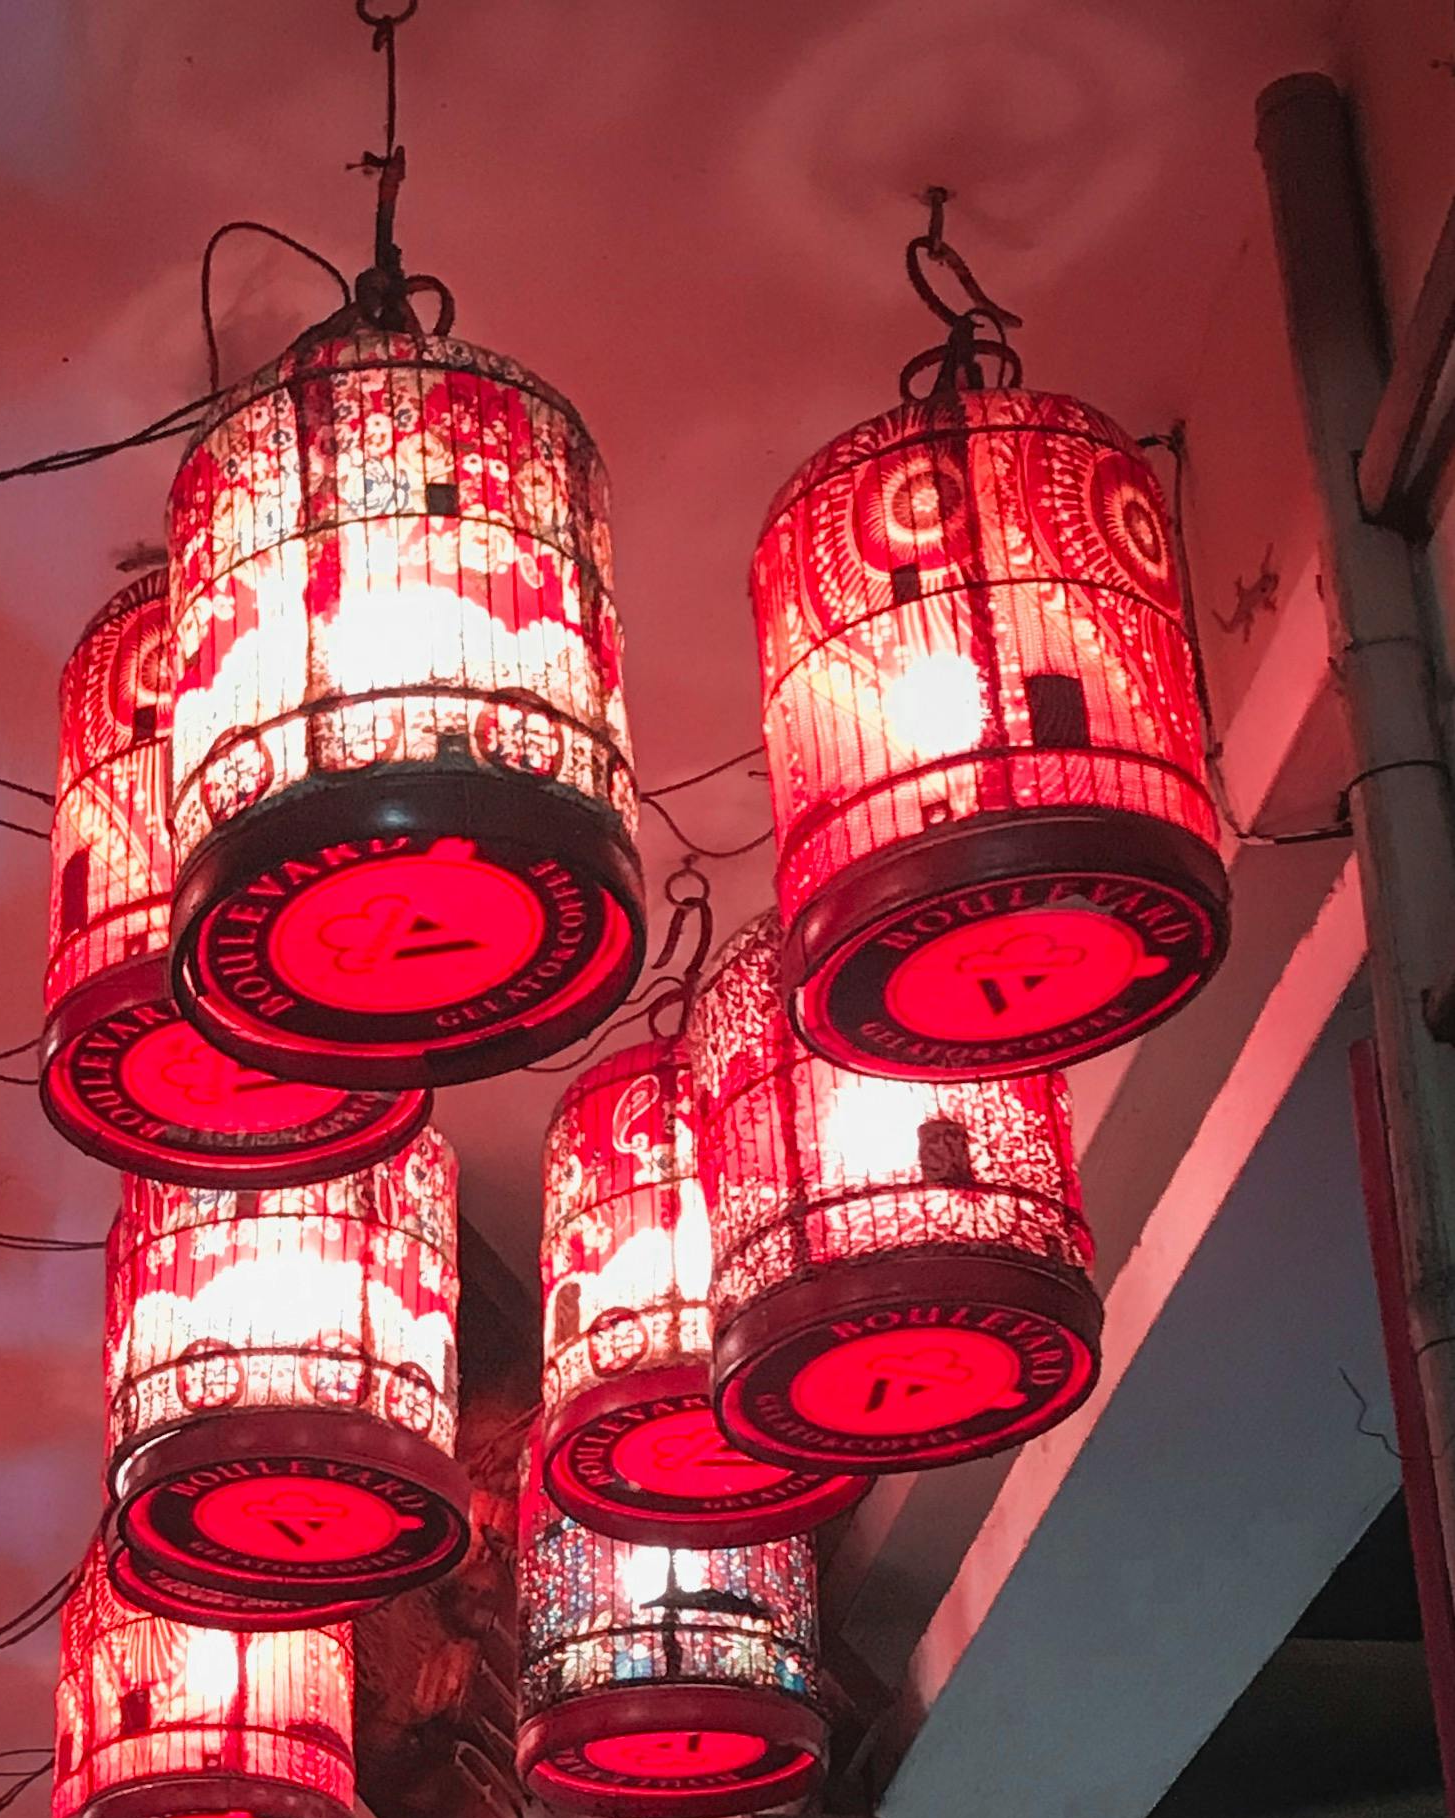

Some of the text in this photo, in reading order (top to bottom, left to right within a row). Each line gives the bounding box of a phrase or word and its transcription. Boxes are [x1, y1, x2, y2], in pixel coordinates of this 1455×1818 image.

[78, 1000, 183, 1139] BOULEVAR
[169, 1460, 427, 1511] BOULEVARD
[578, 1397, 706, 1486] BOULEVAR
